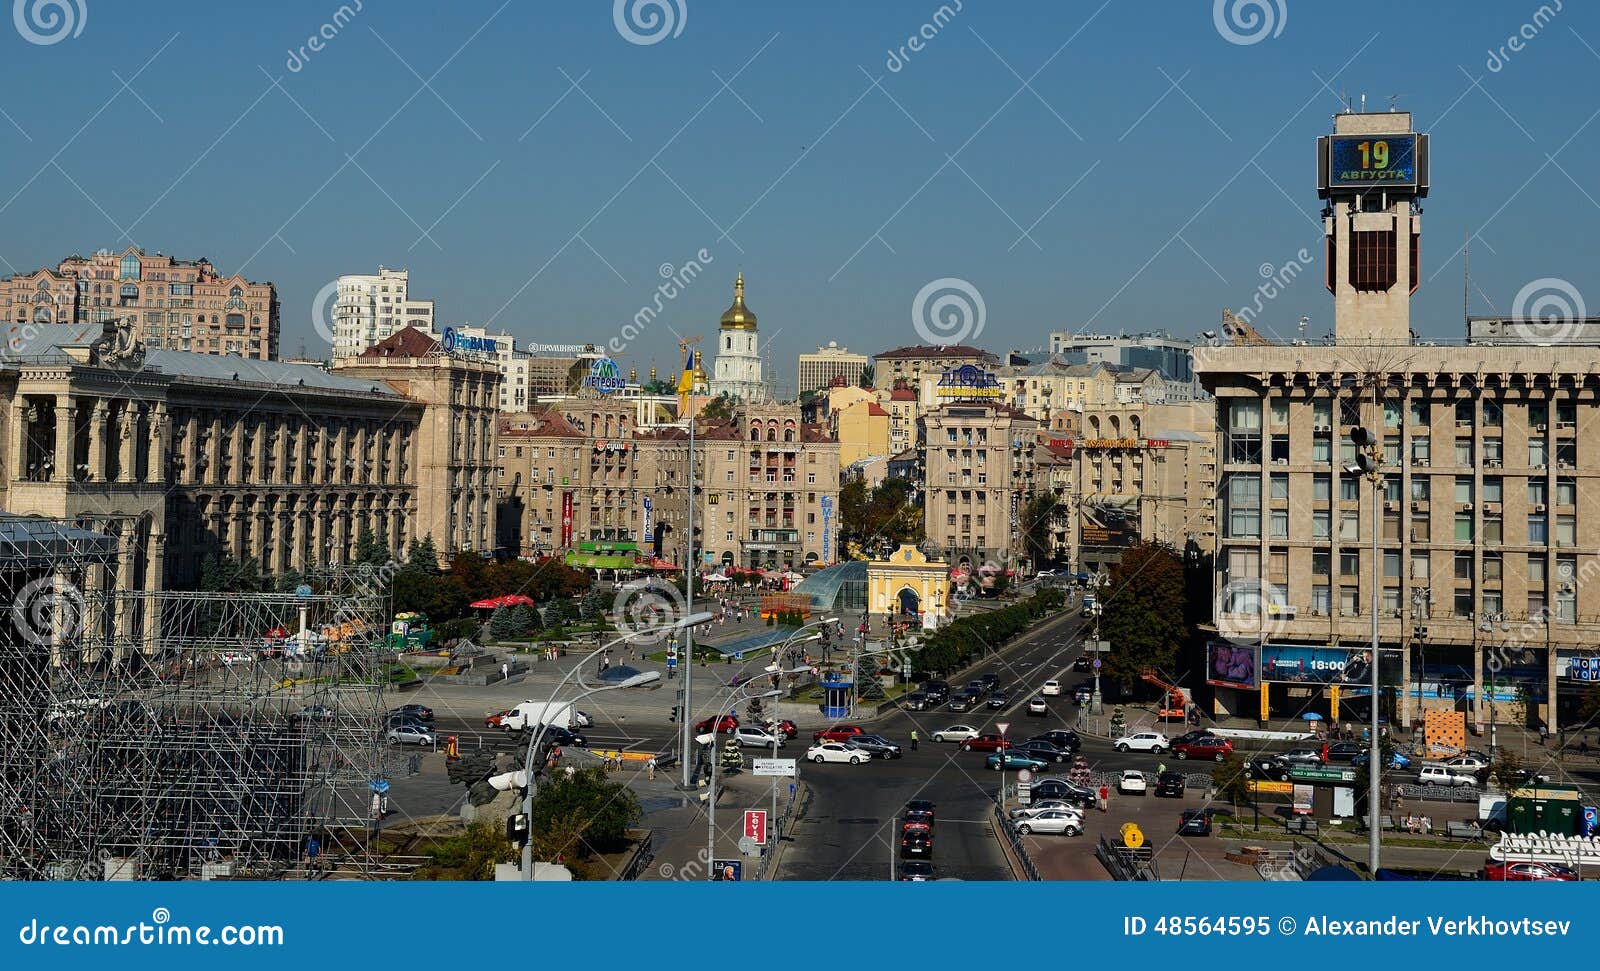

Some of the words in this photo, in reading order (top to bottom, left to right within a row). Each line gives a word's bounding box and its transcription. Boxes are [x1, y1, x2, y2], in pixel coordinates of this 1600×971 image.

[1358, 141, 1389, 169] 19
[1341, 170, 1405, 180] АВГУСТА
[584, 376, 626, 389] МЕТРОБУД
[1310, 660, 1346, 671] 18:00
